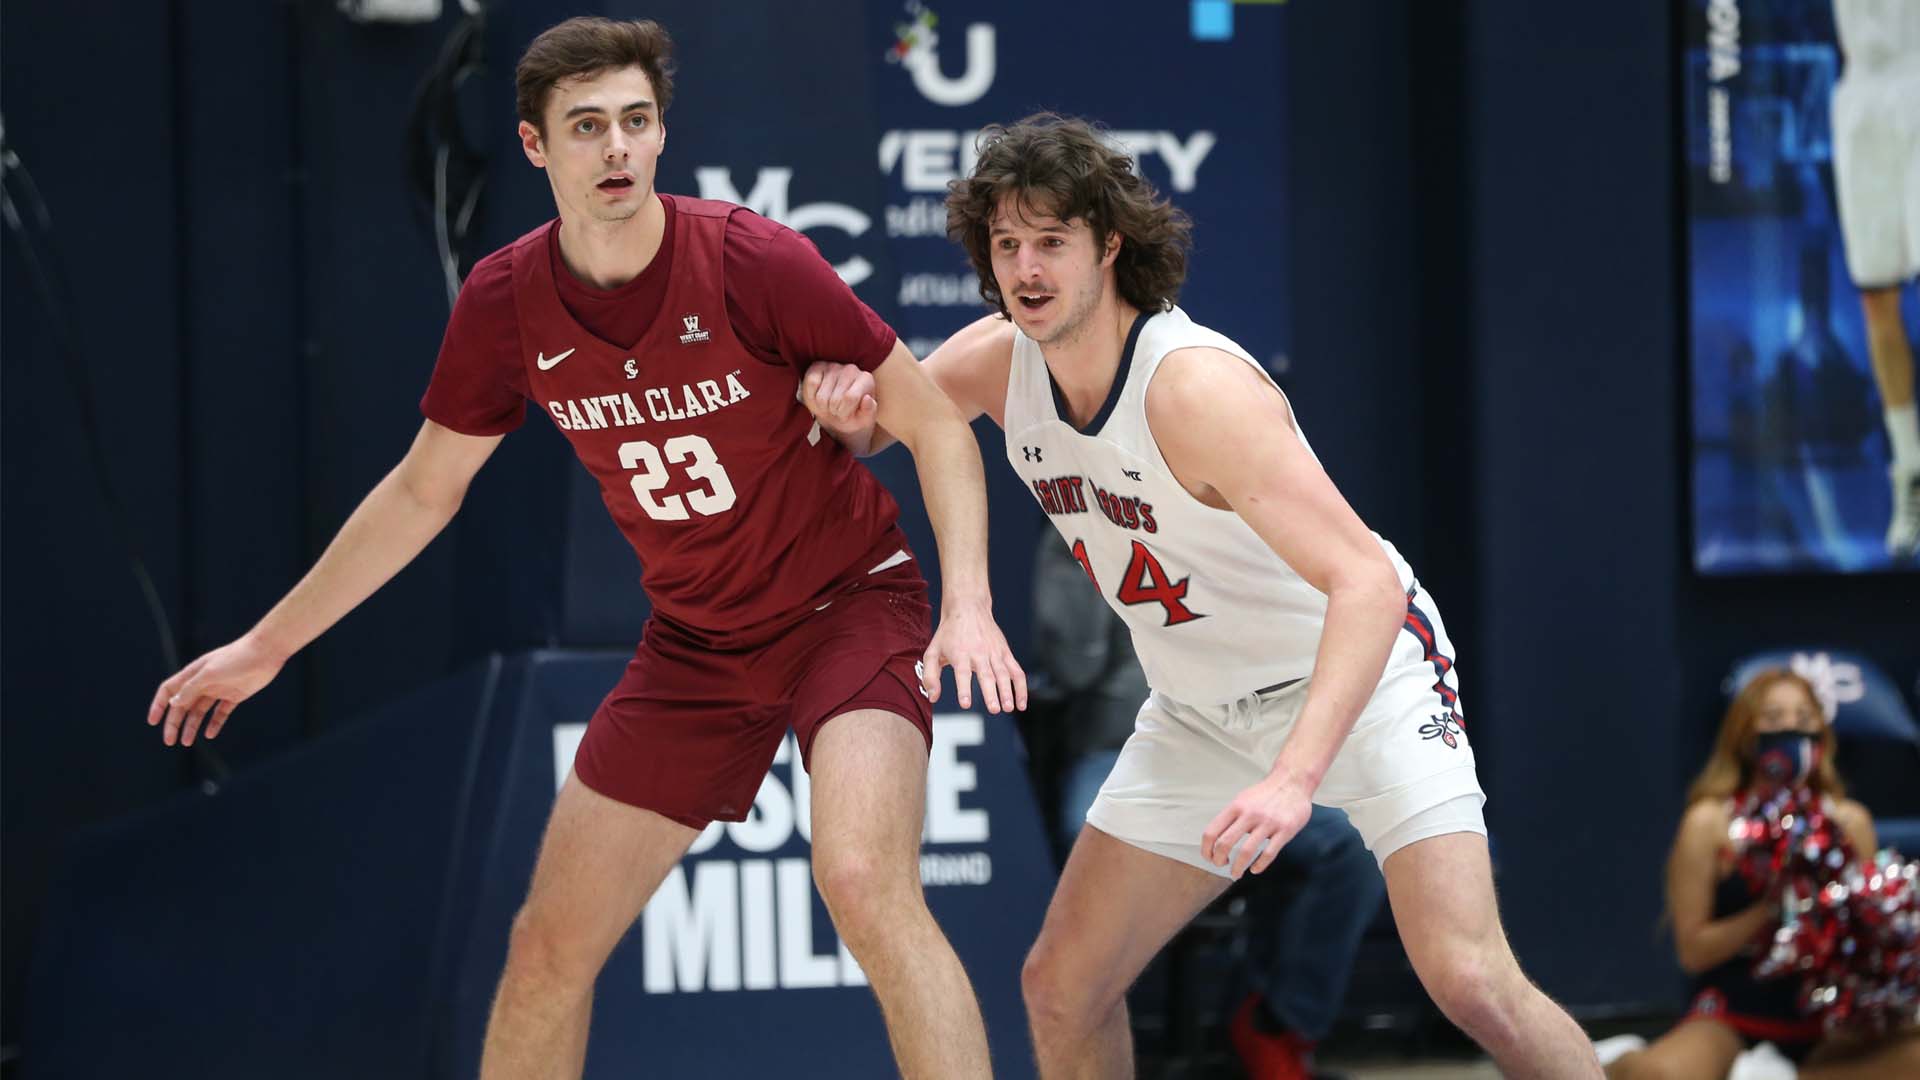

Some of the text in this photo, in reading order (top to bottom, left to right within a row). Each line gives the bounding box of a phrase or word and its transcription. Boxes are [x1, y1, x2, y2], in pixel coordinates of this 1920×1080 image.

[548, 392, 645, 431] SANTA
[644, 373, 751, 422] CLARA
[617, 434, 737, 521] 23
[641, 858, 873, 994] MIL
